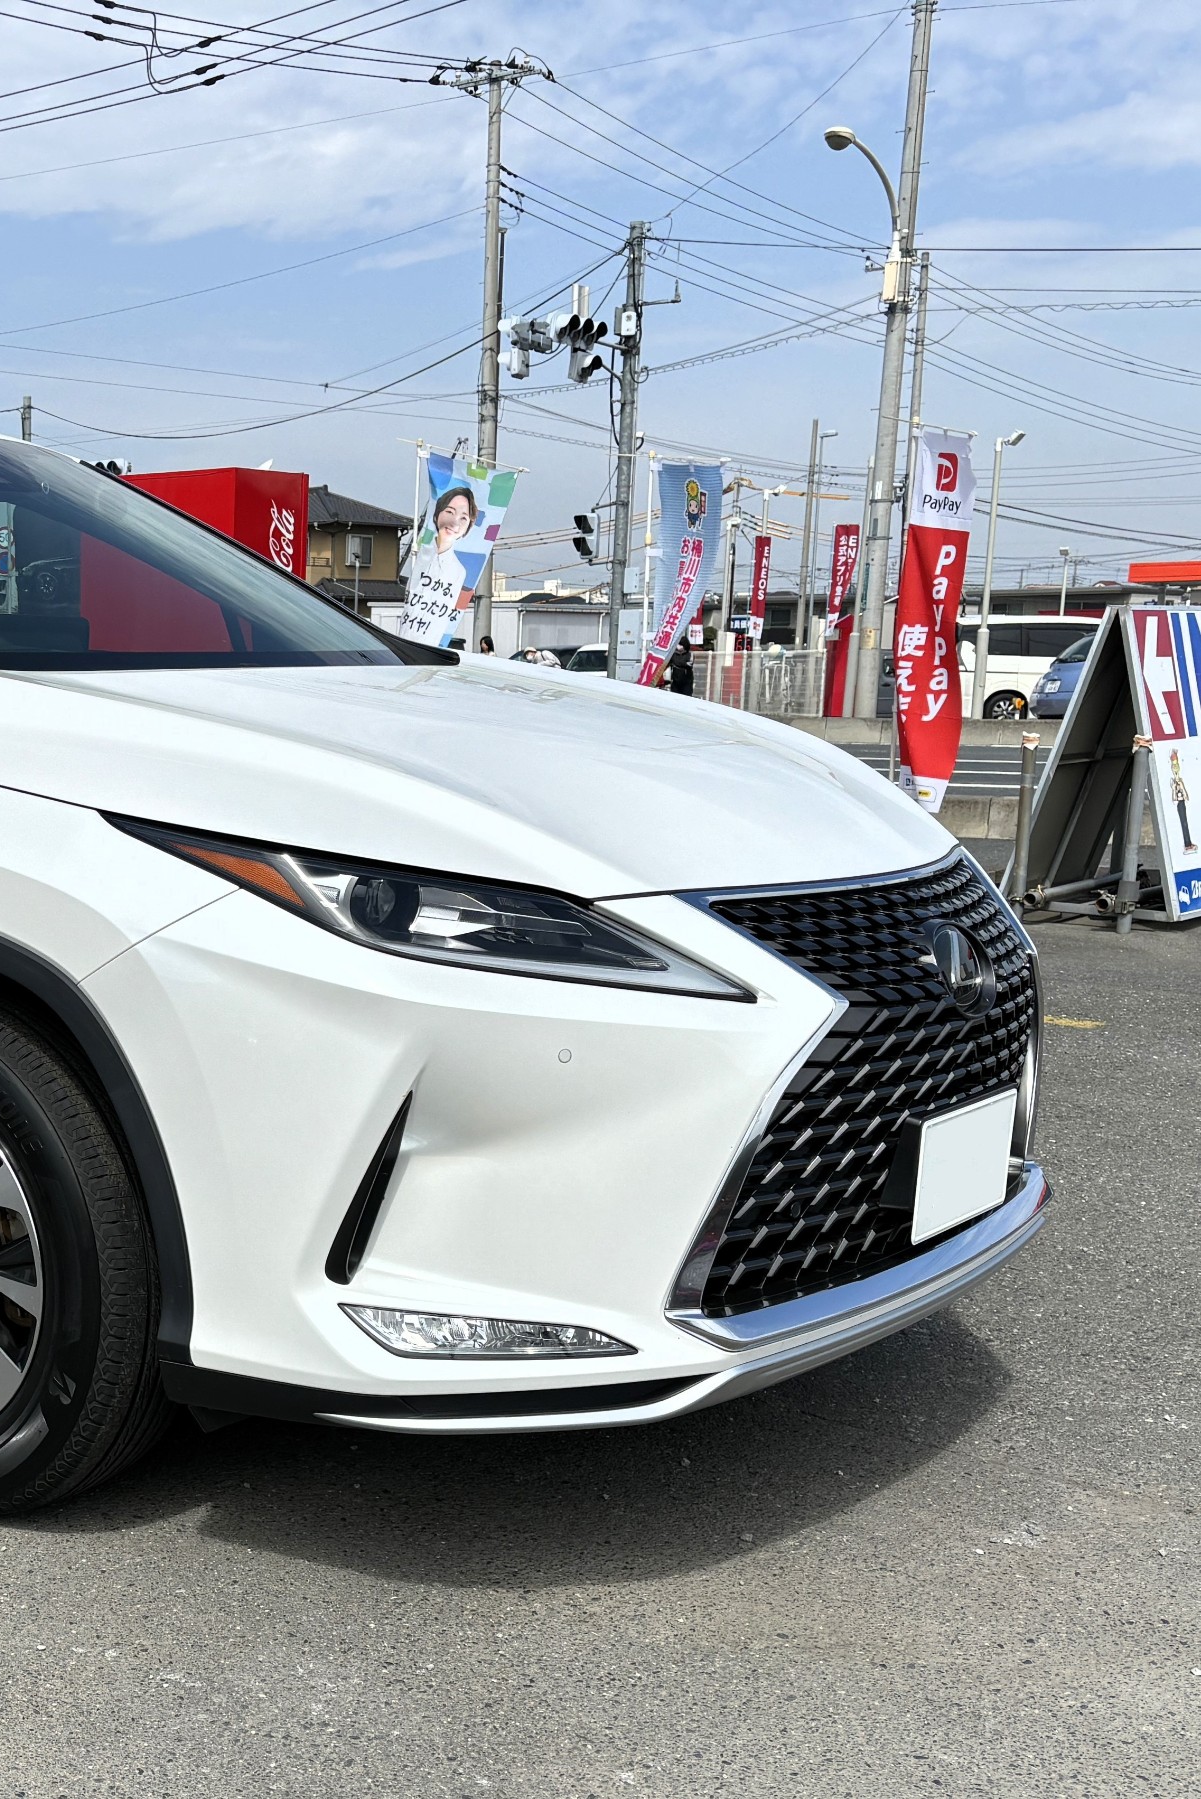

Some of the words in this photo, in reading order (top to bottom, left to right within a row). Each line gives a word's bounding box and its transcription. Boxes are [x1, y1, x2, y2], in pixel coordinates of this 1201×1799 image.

[269, 499, 295, 574] Cola
[922, 494, 962, 515] PayPay
[757, 546, 770, 600] ENEOS
[921, 545, 957, 721] PayPay
